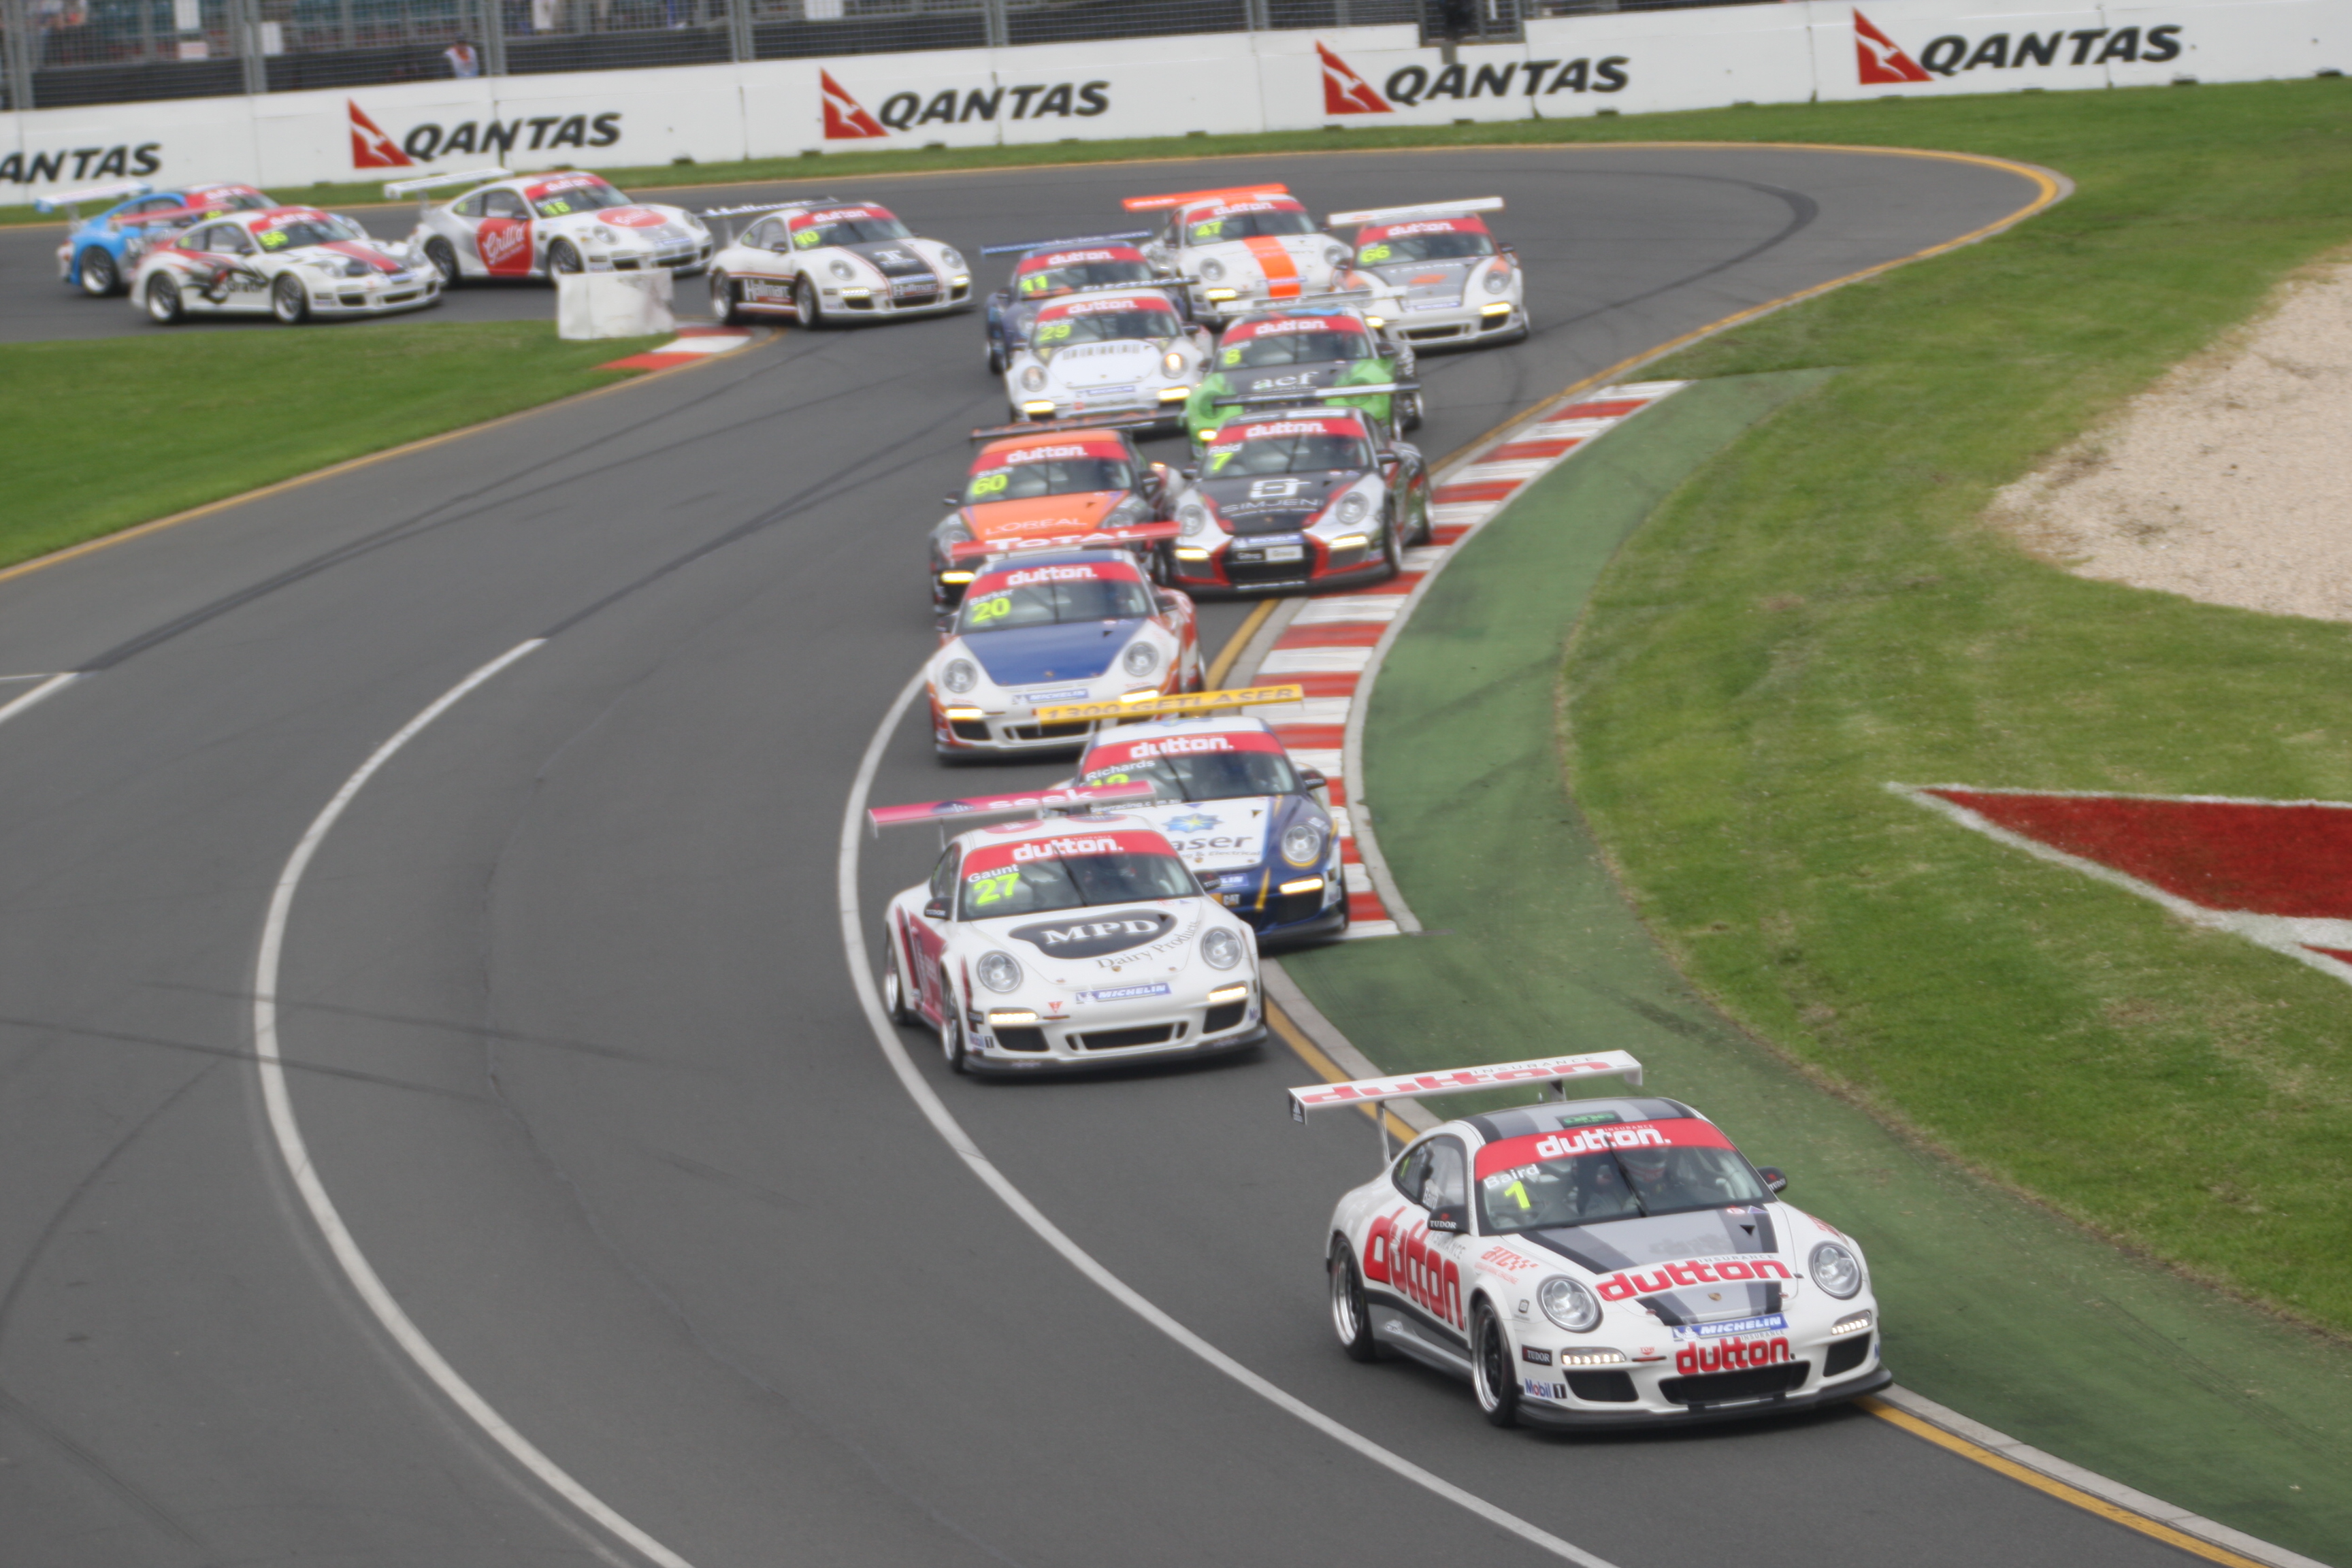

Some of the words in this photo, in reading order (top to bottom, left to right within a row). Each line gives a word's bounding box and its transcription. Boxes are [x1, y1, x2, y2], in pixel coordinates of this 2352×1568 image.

[1921, 24, 2182, 76] QANTAS
[1385, 56, 1630, 106] QANTAS
[879, 80, 1110, 131] QANTAS
[404, 112, 621, 162] QANTAS
[794, 231, 819, 245] 10
[1196, 221, 1222, 236] 47
[1360, 245, 1391, 263] 66
[1022, 275, 1048, 292] 11
[1039, 324, 1071, 342] 29
[1224, 348, 1241, 365] 8
[1211, 452, 1233, 470] 7
[972, 474, 1008, 495] 60
[971, 596, 1011, 623] 20
[1046, 702, 1122, 721] 1300
[1085, 760, 1156, 782] Richards
[988, 788, 1098, 809] seek
[967, 863, 1020, 884] Gaunt
[973, 872, 1020, 906] 27
[1040, 919, 1160, 946] MPD
[1094, 950, 1154, 970] Dairy
[1156, 918, 1203, 954] Products
[1096, 984, 1167, 1000] MICHELIN
[1604, 1124, 1655, 1132] INSURANCE
[1483, 1164, 1541, 1190] Baird
[1504, 1180, 1532, 1209] 1
[1429, 1220, 1457, 1229] TUDOR
[1699, 1253, 1776, 1264] INSURANCE
[1699, 1316, 1782, 1335] MICHELIN
[1741, 1329, 1785, 1341] INSURANCE
[1527, 1351, 1550, 1362] TUDOR
[1524, 1377, 1552, 1399] Mobil
[1555, 1383, 1563, 1398] 1
